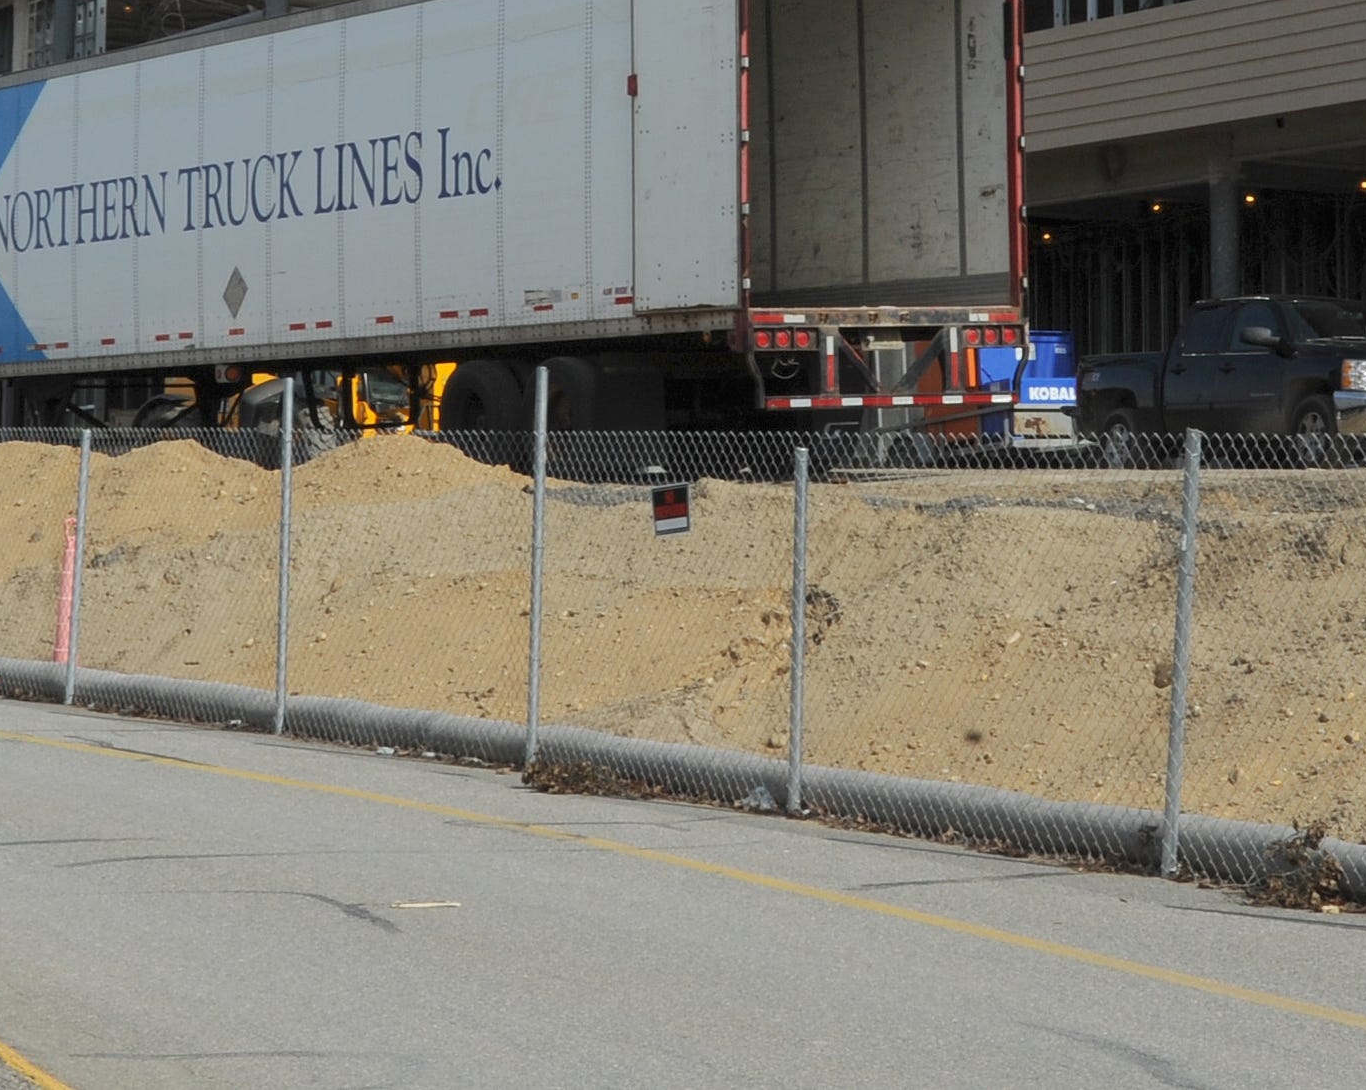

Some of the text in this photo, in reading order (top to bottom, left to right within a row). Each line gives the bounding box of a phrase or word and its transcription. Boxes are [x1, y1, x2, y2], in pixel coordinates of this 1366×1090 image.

[177, 149, 303, 232] TRUCK
[313, 131, 423, 215] LINES
[437, 127, 502, 199] Inc.
